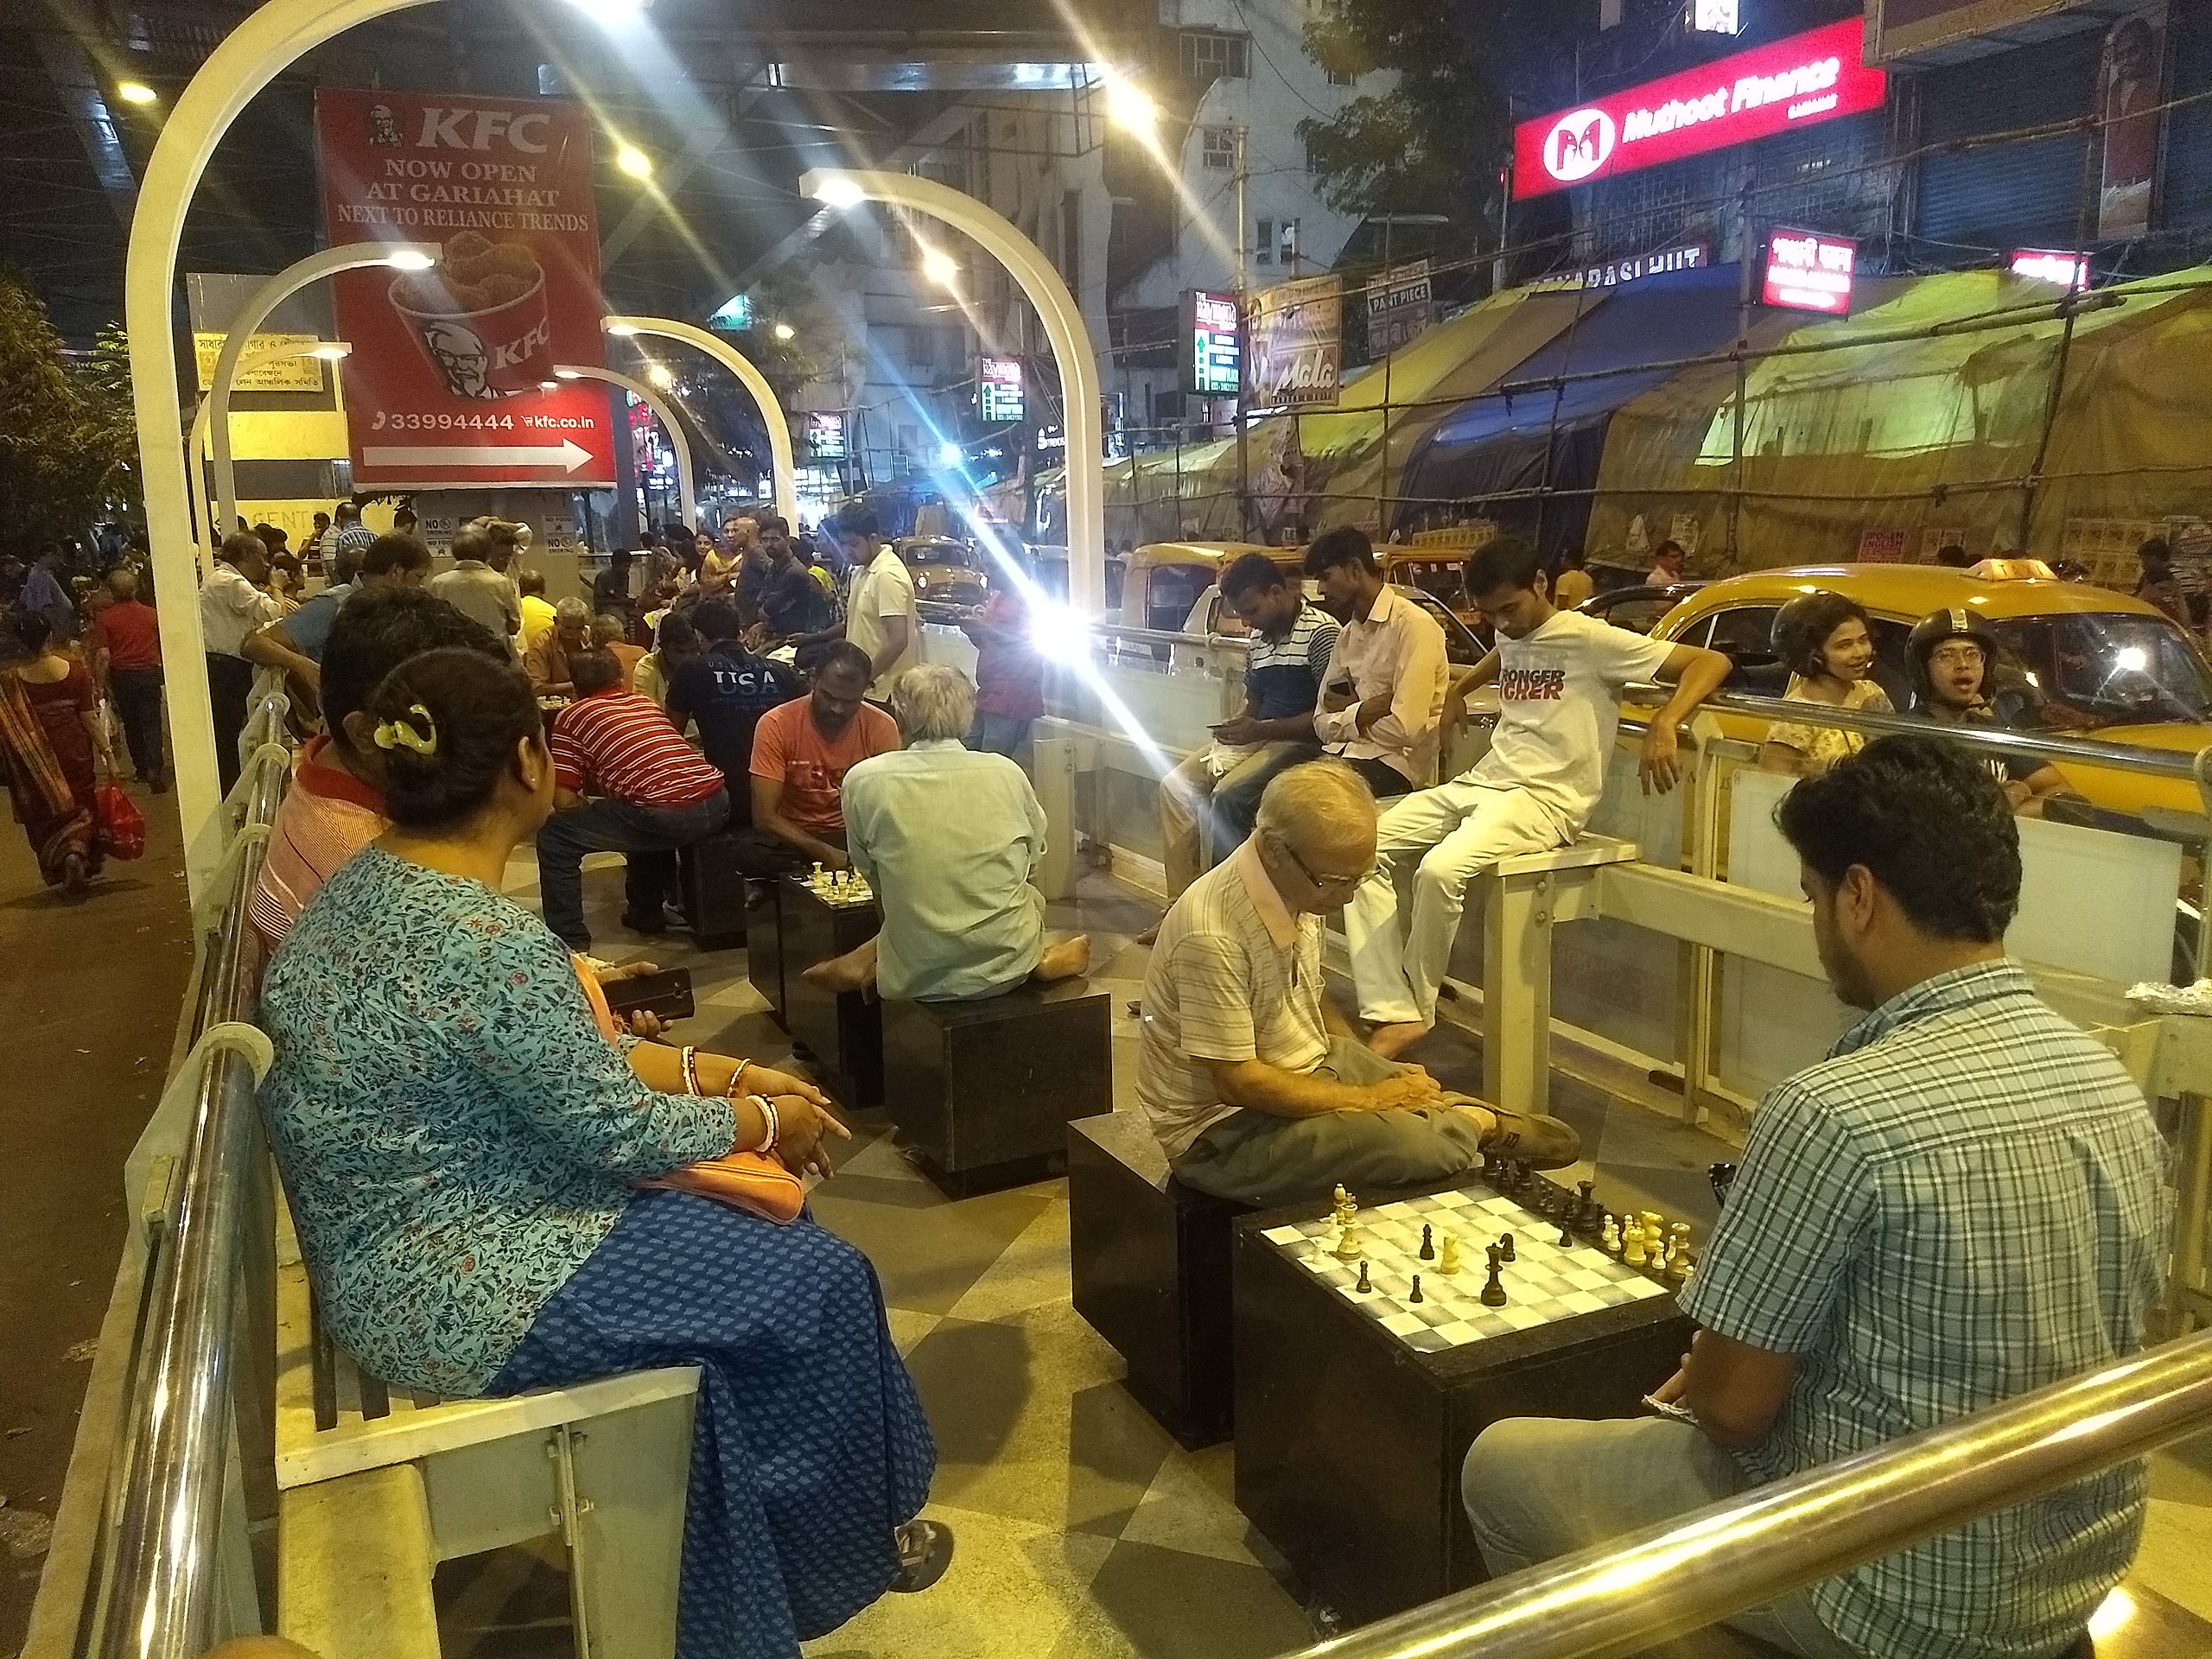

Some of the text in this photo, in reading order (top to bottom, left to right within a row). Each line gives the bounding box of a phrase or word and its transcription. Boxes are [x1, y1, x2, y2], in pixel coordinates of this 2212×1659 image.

[1622, 57, 1840, 144] Muthoot Finance
[416, 107, 551, 154] KFC
[385, 159, 537, 183] NOW OPEN
[365, 182, 559, 207] AT GARIAHAT
[338, 205, 588, 232] NEXT TO RELIANCE TRENDS
[1400, 285, 1426, 304] PIECE
[494, 315, 549, 370] KFC
[391, 414, 594, 430] 33994444 kfc.co.in
[426, 519, 439, 529] NO
[548, 538, 560, 548] NO
[713, 671, 780, 696] USA
